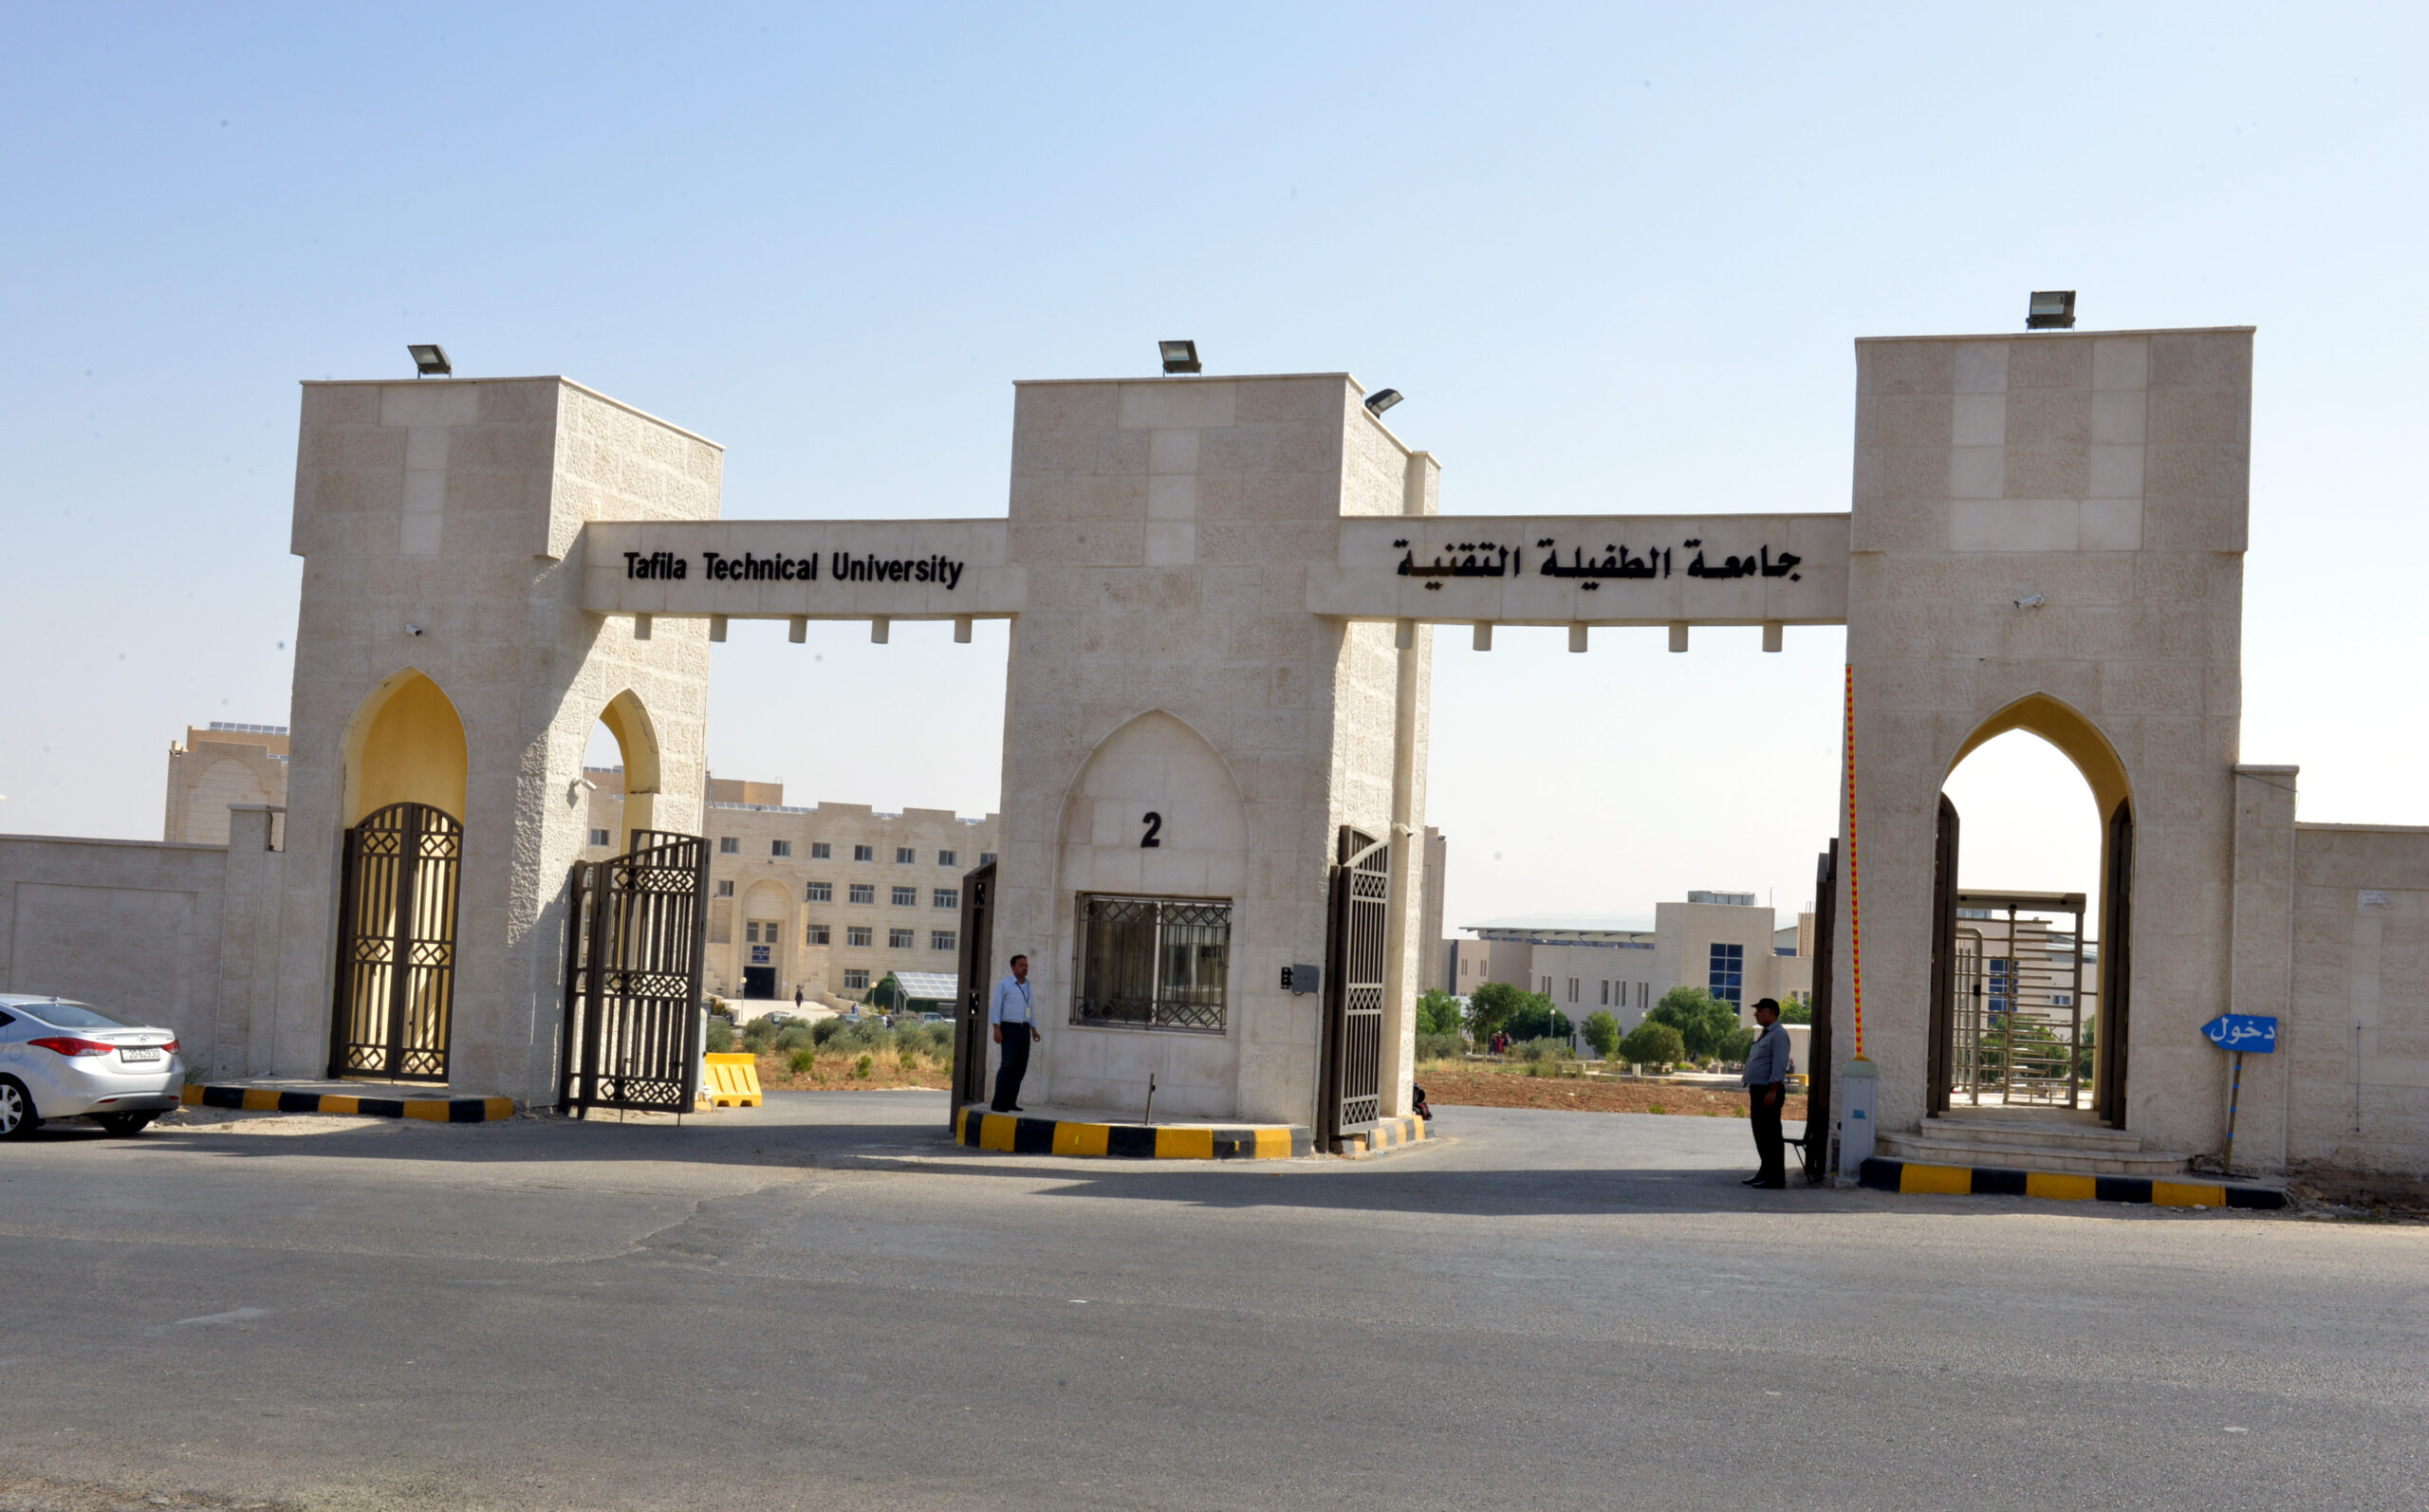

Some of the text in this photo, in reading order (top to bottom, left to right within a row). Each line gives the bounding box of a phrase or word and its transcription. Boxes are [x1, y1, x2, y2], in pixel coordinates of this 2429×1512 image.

[622, 551, 965, 591] Tafila Technical University
[1392, 537, 1803, 592] جامعة الطفيلة التقنية
[1140, 811, 1162, 849] 2
[2210, 1017, 2275, 1044] دخول
